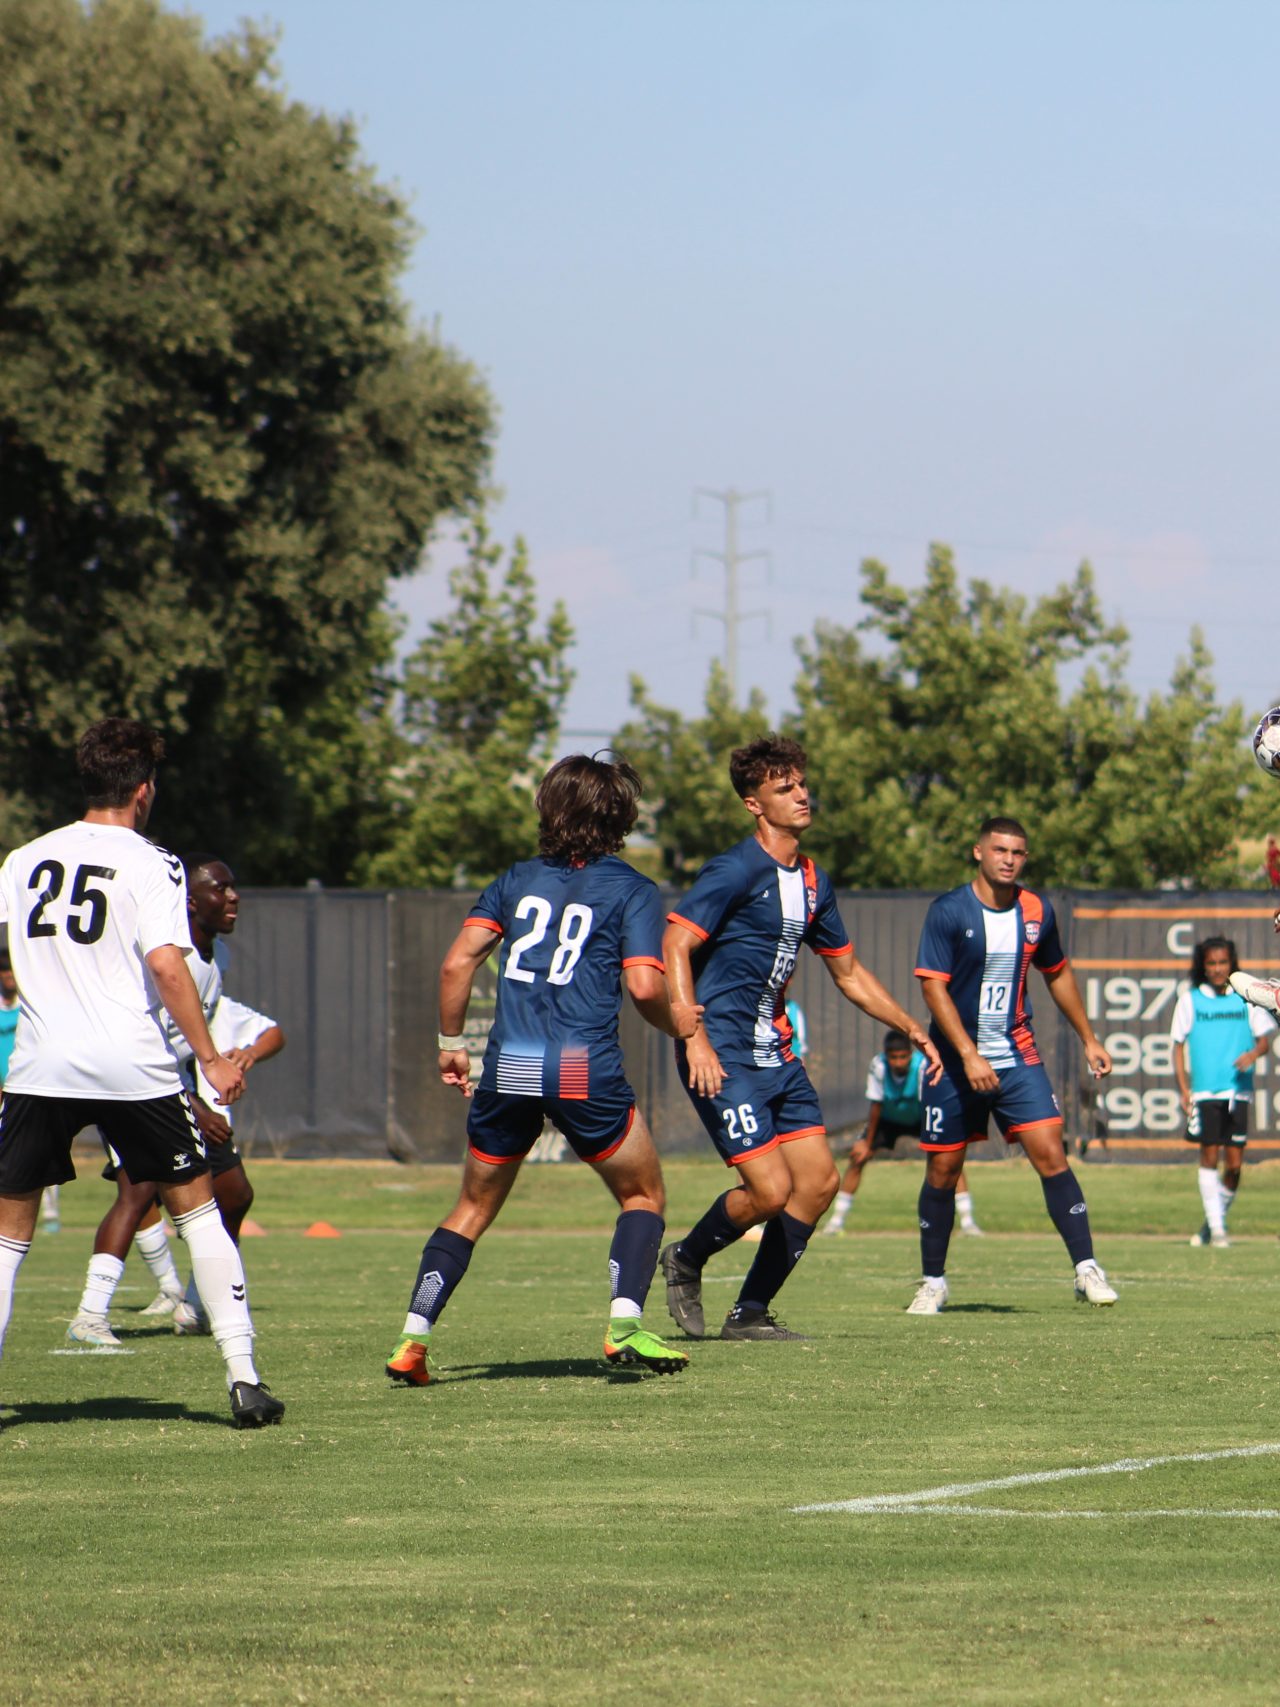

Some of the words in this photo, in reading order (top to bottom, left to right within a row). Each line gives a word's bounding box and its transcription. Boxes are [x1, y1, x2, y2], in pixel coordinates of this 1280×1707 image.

[27, 859, 116, 945] 25
[503, 895, 594, 986] 28
[770, 956, 796, 985] 26
[987, 984, 1007, 1012] 12
[1086, 977, 1189, 1021] 197
[1096, 1032, 1191, 1076] 98
[722, 1103, 759, 1141] 26
[925, 1105, 944, 1133] 12
[1098, 1088, 1182, 1132] 98
